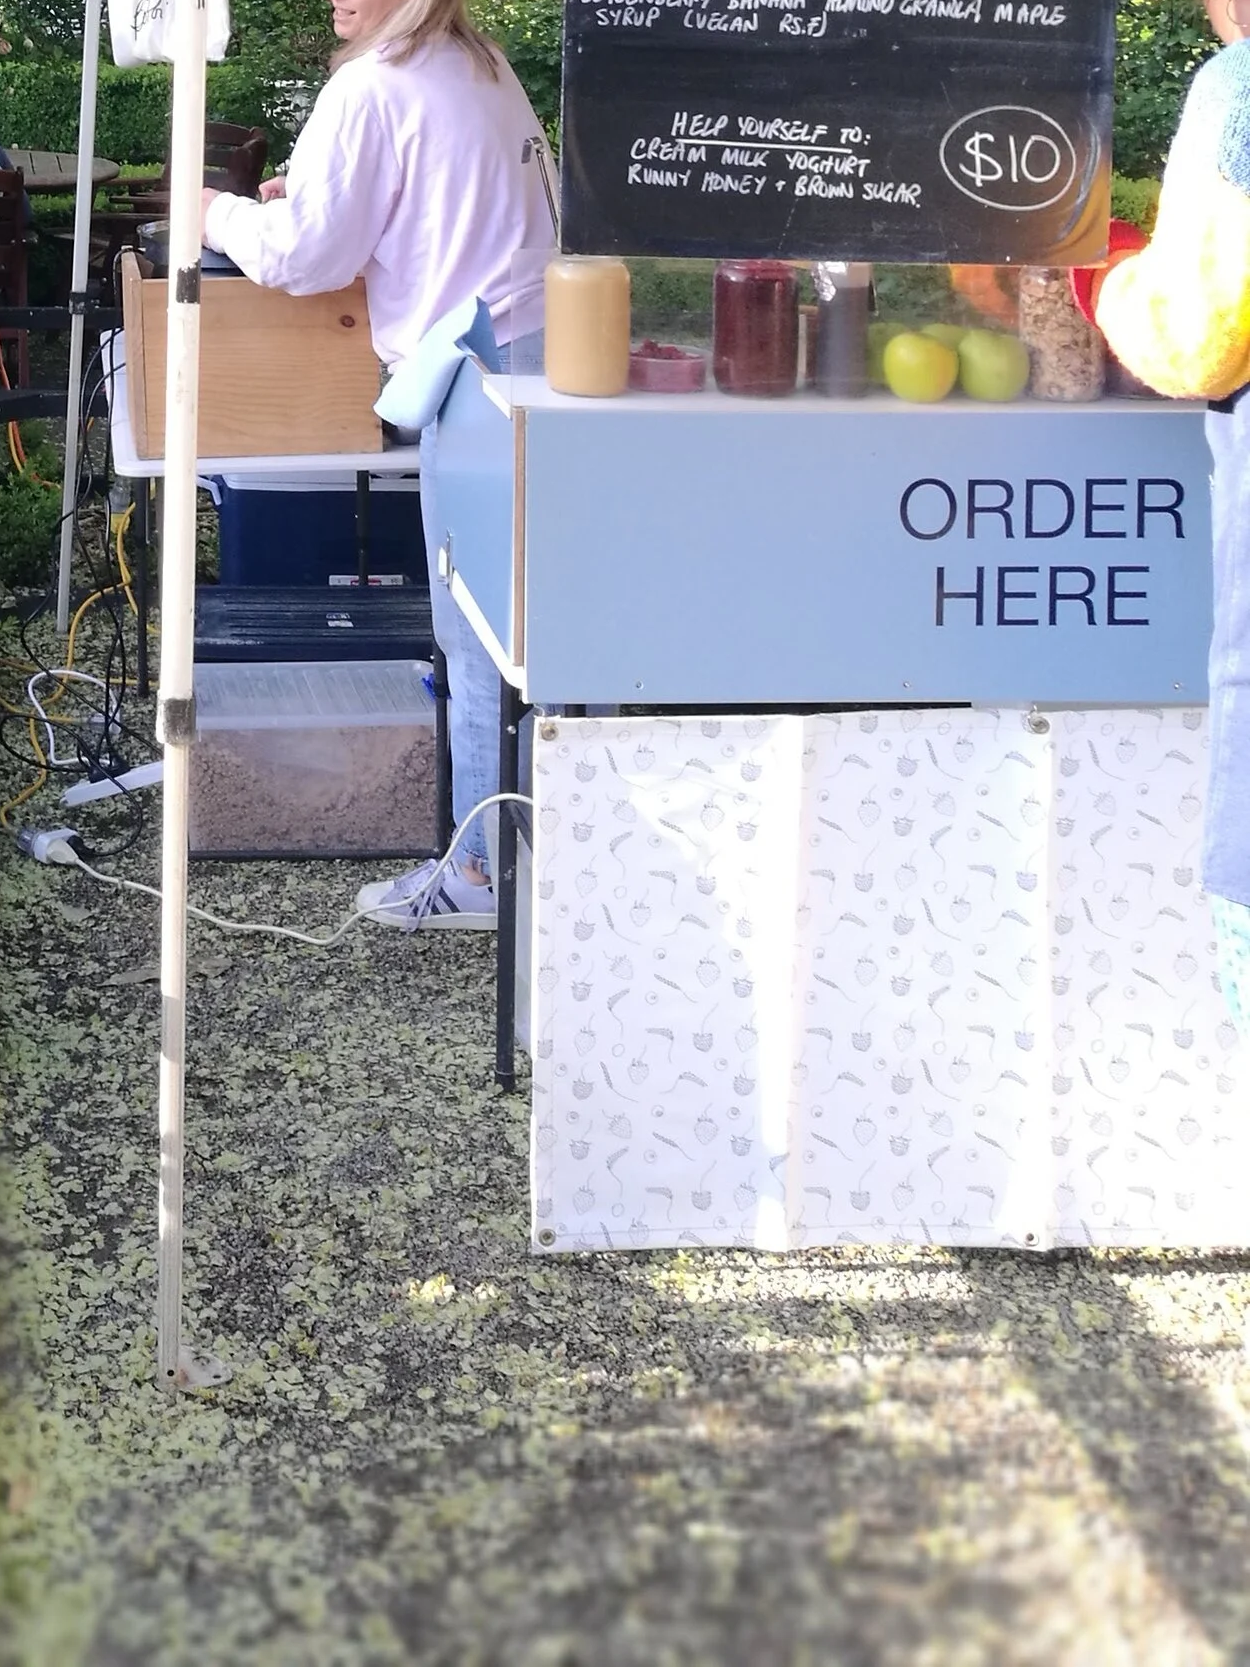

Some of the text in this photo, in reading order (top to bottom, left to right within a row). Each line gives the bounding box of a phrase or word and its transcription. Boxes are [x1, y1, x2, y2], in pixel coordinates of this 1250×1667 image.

[597, 7, 660, 27] SYRUP
[683, 9, 759, 32] (VEGAN
[994, 3, 1066, 26] MAPLE
[671, 111, 871, 146] HELP YOURSELF TO:
[630, 137, 871, 178] CREAM MILK YOGHURT
[959, 130, 1061, 188] $10
[628, 164, 691, 188] RUNNY
[701, 173, 765, 196] HONEY
[794, 176, 854, 199] BROWN
[899, 477, 1186, 540] ORDER
[933, 565, 1151, 627] HERE
